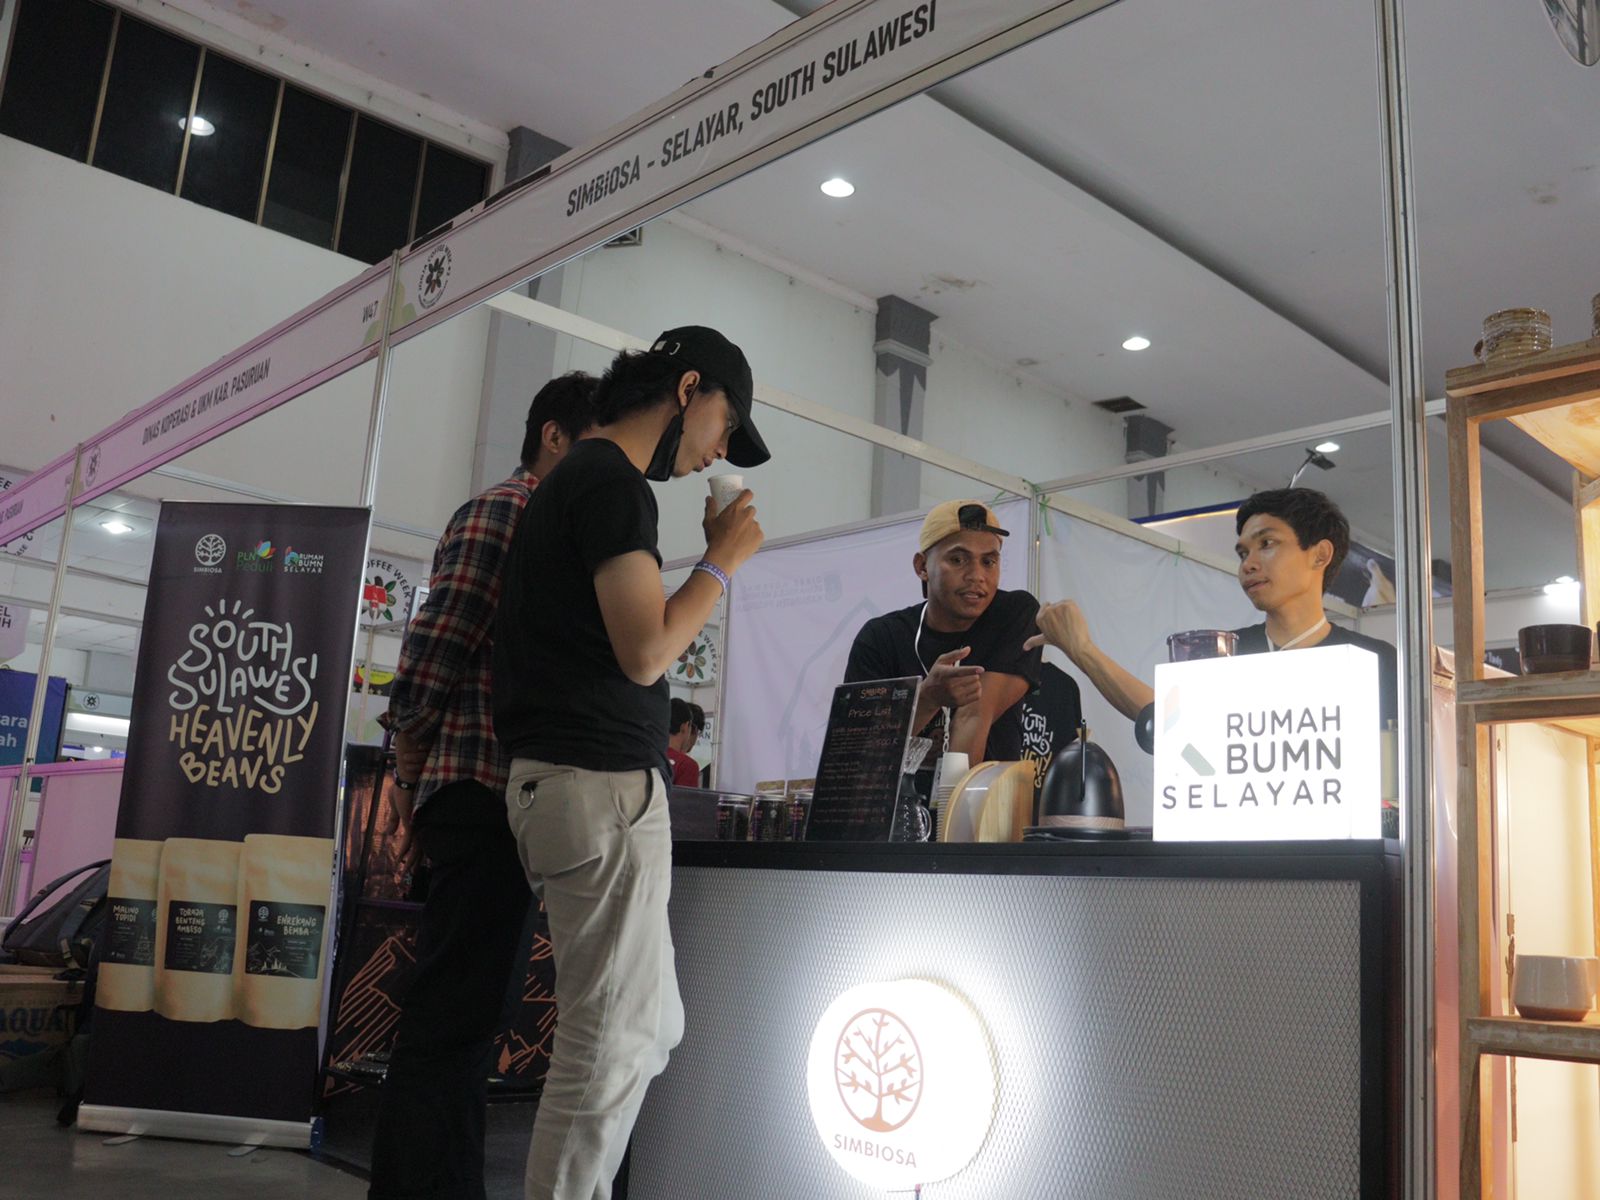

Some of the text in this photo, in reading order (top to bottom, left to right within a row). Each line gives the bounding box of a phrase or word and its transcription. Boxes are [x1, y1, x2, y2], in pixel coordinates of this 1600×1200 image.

[661, 102, 744, 168] SELAYAR,
[750, 61, 815, 122] SOUTH
[822, 0, 936, 84] SULAWESI
[230, 357, 271, 397] PASURUAN
[193, 551, 257, 574] SIMBIOSA PLN
[283, 566, 323, 574] SELAYAR
[298, 560, 324, 568] BUMN
[177, 620, 293, 673] SOUTH
[167, 652, 318, 716] SULAWESI
[847, 707, 872, 718] Price
[1227, 704, 1342, 739] RUMAH
[169, 701, 319, 766] HEAVENLY
[179, 751, 286, 794] BEANS
[1227, 737, 1342, 775] BUMN
[1162, 778, 1342, 810] SELAYAR
[833, 1133, 917, 1168] SIMBIOSA
